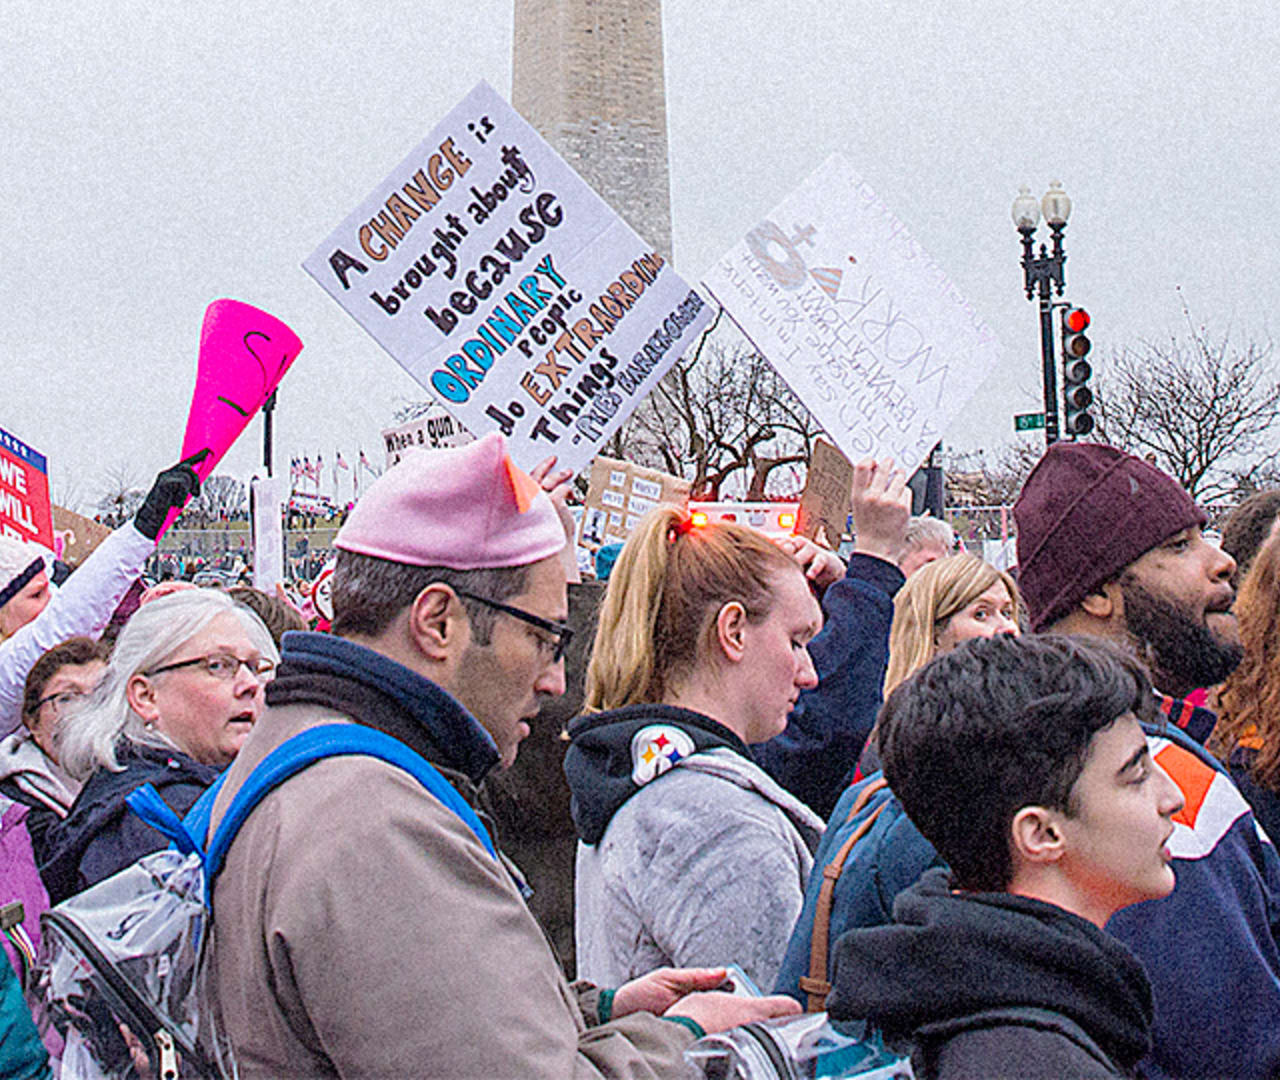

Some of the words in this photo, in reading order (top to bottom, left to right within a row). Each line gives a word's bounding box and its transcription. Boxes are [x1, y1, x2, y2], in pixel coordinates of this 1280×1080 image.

[328, 248, 369, 290] A
[358, 136, 473, 262] CHANGE
[467, 114, 496, 144] is
[369, 212, 470, 318] brought
[466, 144, 537, 226] about
[423, 191, 565, 337] because
[430, 254, 568, 405] ORDINARY
[529, 346, 619, 446] Things
[428, 415, 455, 449] gun
[485, 399, 526, 438] do
